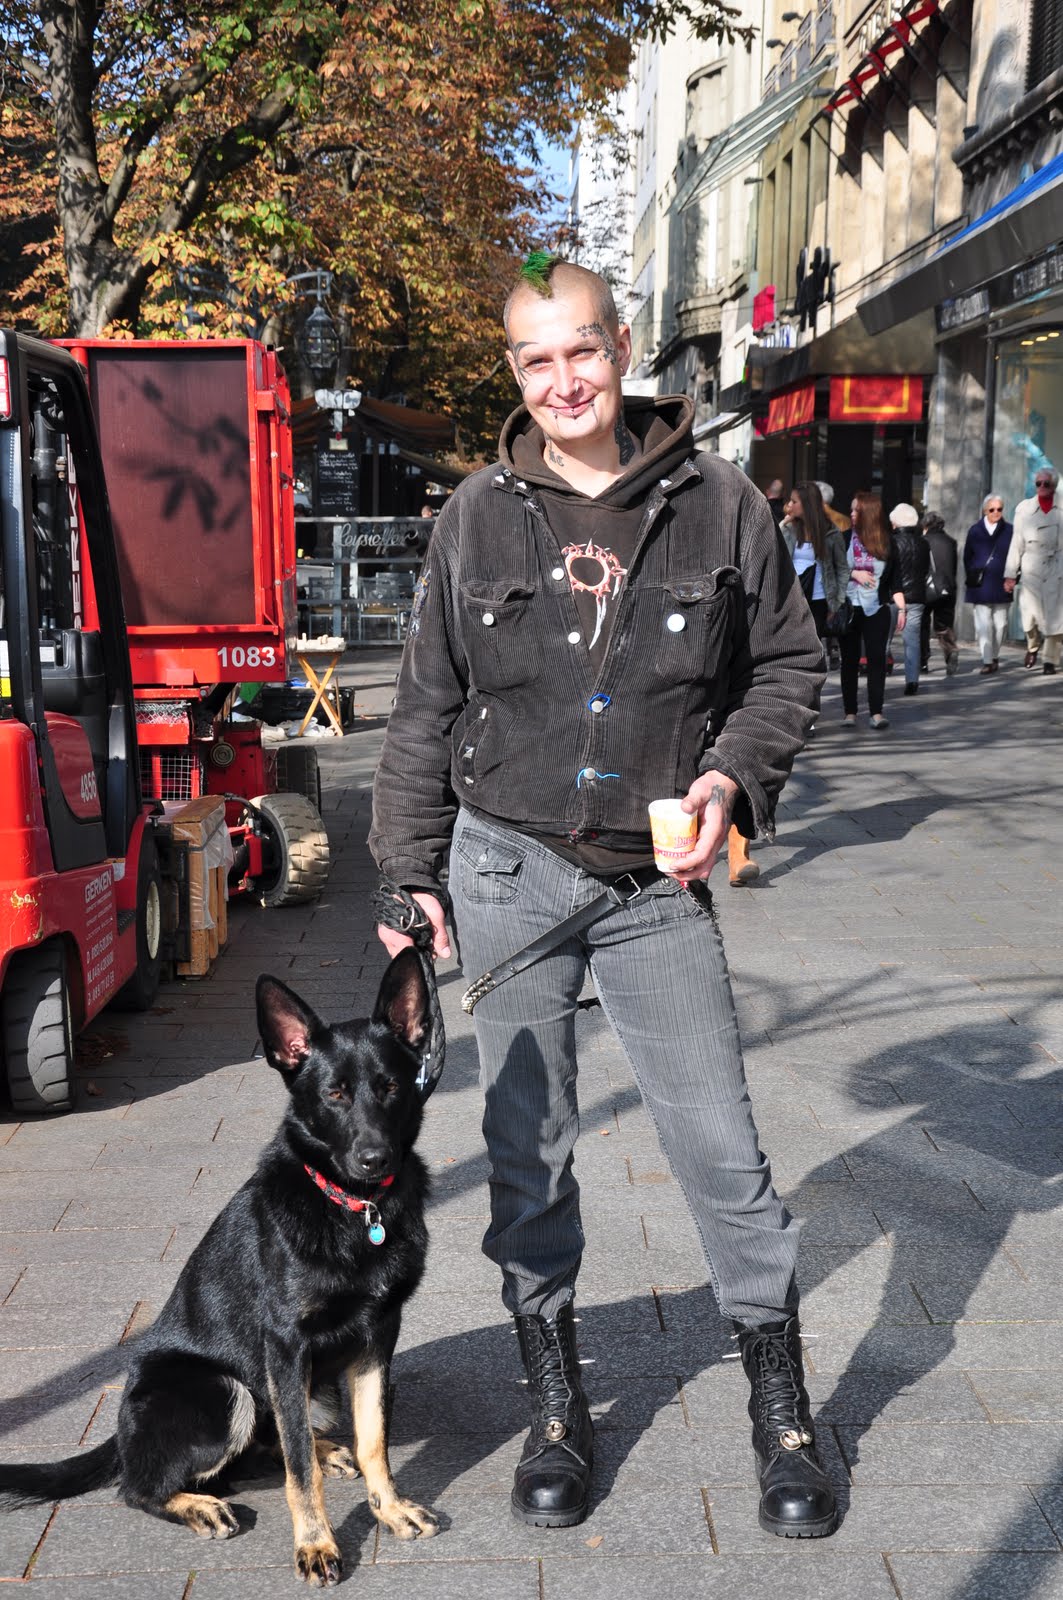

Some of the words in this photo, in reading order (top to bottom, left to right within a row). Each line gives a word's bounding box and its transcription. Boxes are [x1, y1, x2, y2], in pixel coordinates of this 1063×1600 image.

[65, 433, 82, 630] ERKE
[333, 523, 418, 555] Leysieffer
[217, 646, 276, 668] 1083
[80, 770, 97, 803] 4856
[84, 869, 112, 904] GERKEN
